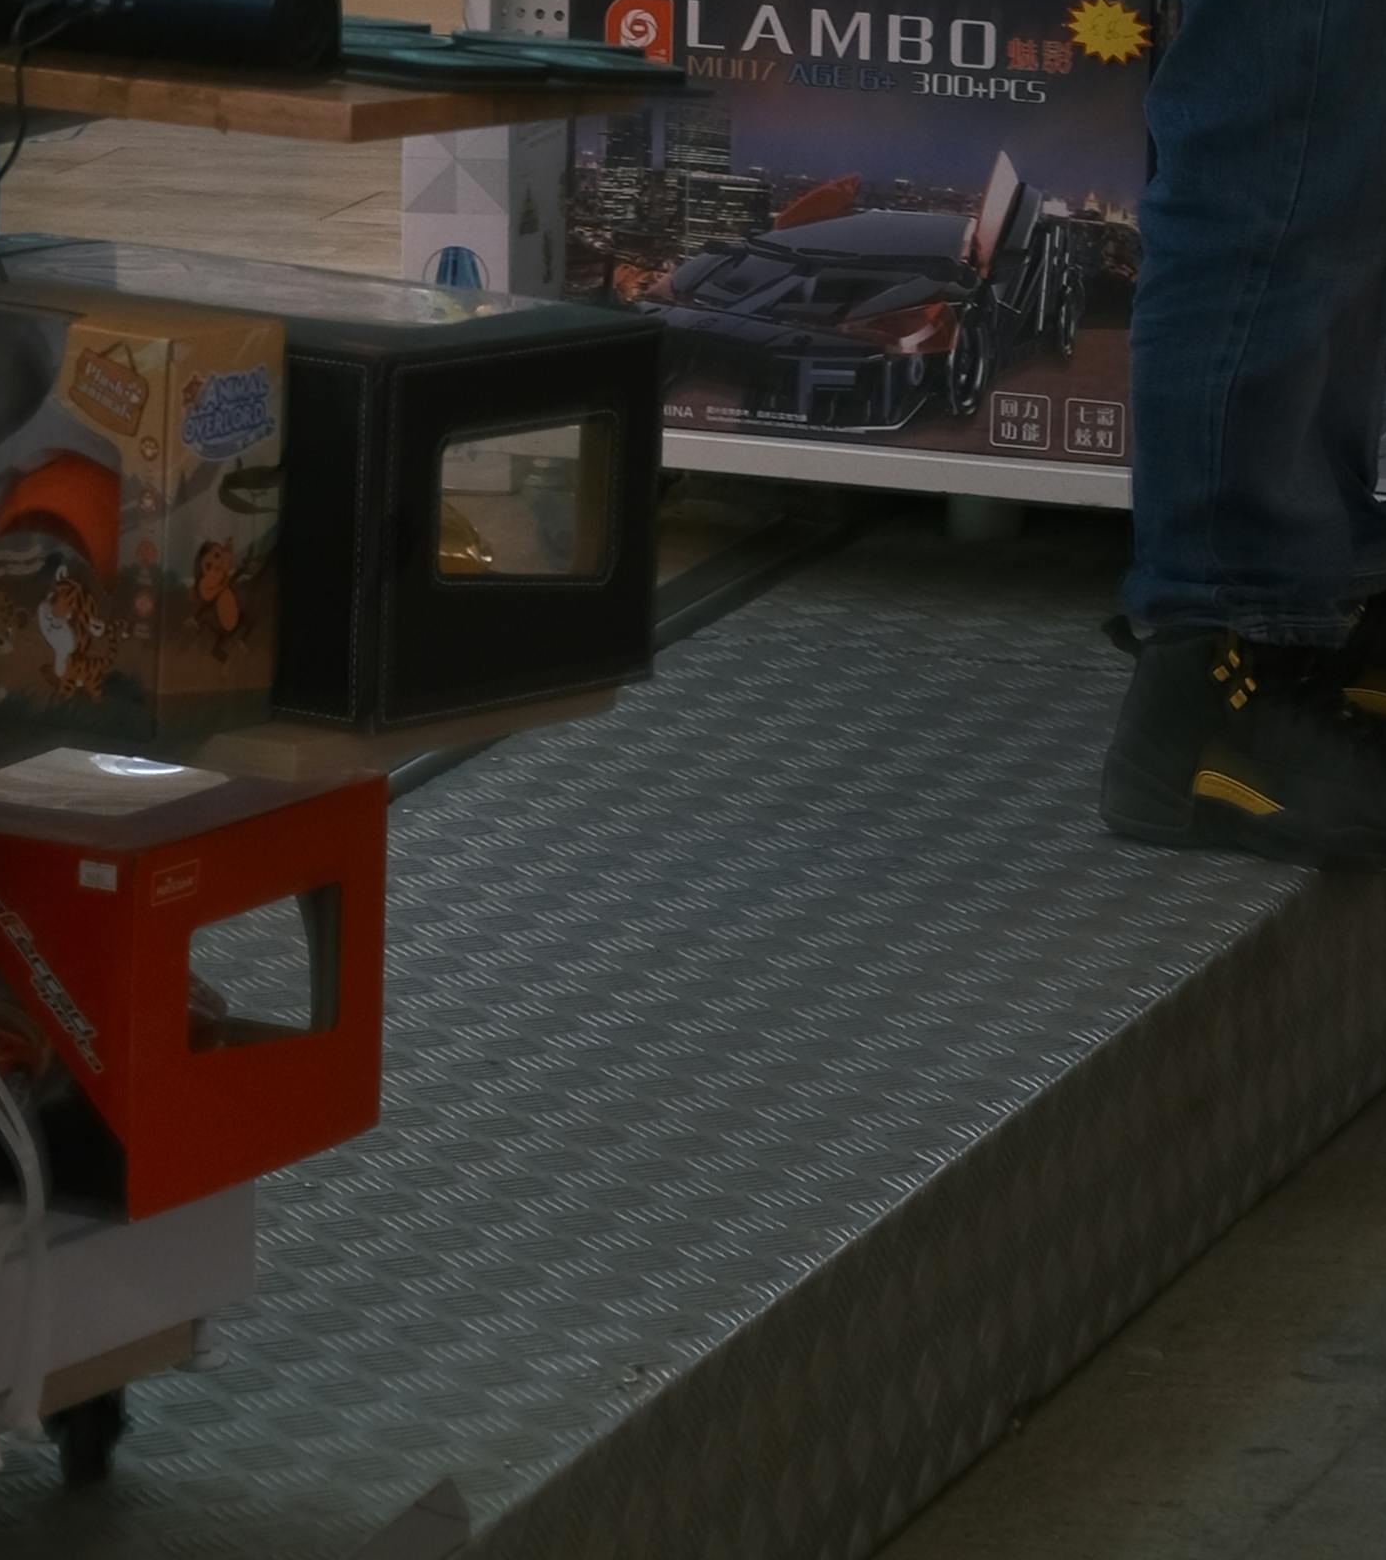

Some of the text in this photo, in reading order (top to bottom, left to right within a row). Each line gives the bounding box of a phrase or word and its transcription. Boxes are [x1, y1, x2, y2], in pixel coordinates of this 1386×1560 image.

[787, 62, 854, 89] AGE
[858, 70, 899, 91] 6+
[911, 70, 1047, 103] 300+PCS
[83, 360, 124, 396] Plush
[201, 362, 268, 407] ANIMAL
[182, 401, 268, 444] OVERLORD
